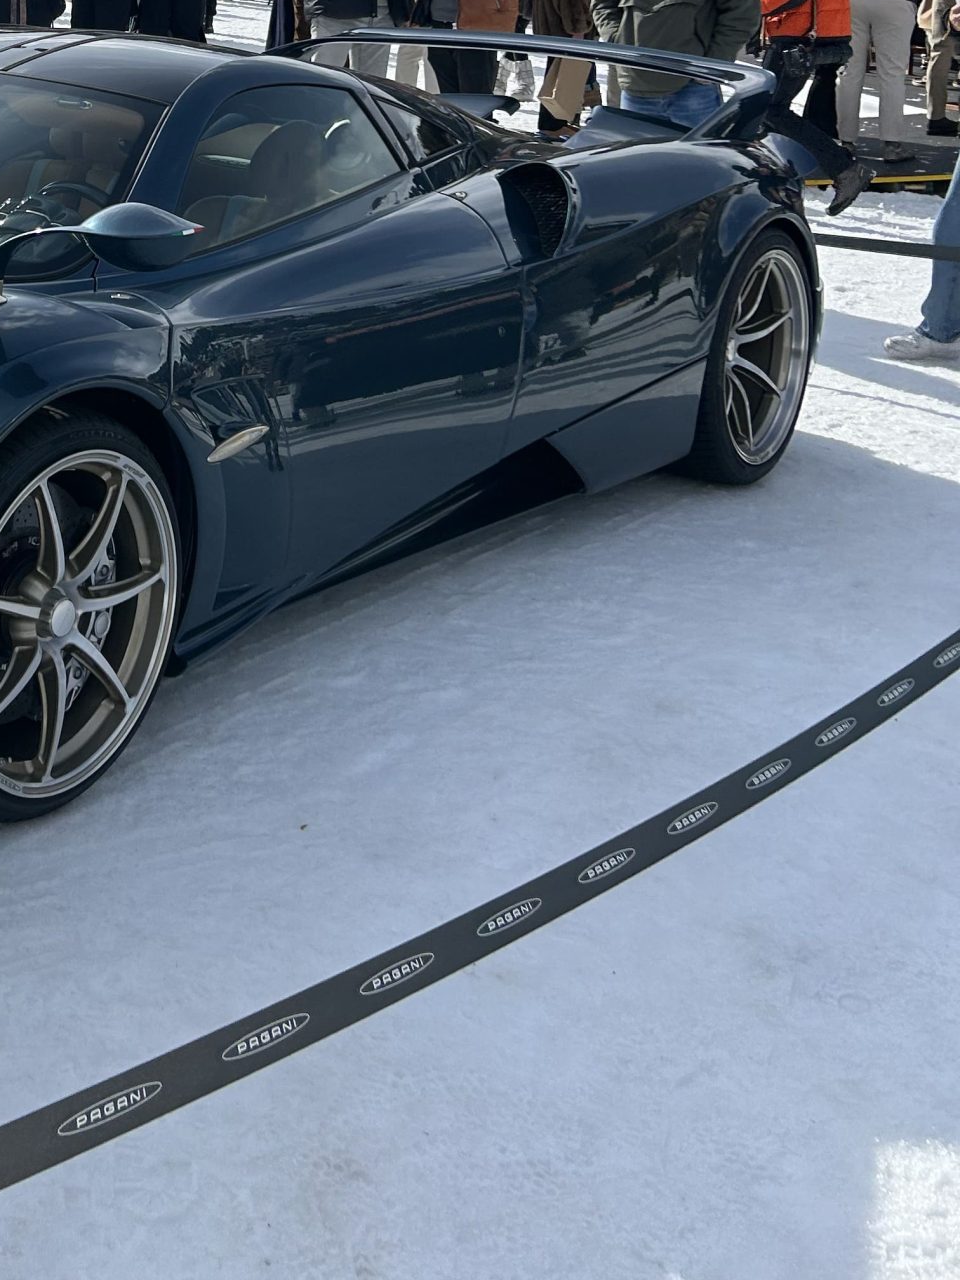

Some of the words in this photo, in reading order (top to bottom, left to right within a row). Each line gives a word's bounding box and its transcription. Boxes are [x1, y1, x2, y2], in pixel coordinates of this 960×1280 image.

[883, 682, 909, 702] PAGANI
[821, 721, 851, 743] PAGANI
[752, 762, 785, 786] PAGANI
[675, 805, 711, 830] PAGANI
[587, 852, 627, 878] PAGANI
[487, 901, 533, 932] PAGANI
[372, 957, 424, 989] PAGANI
[237, 1018, 297, 1054] PAGANI
[76, 1086, 147, 1128] PAGANI
